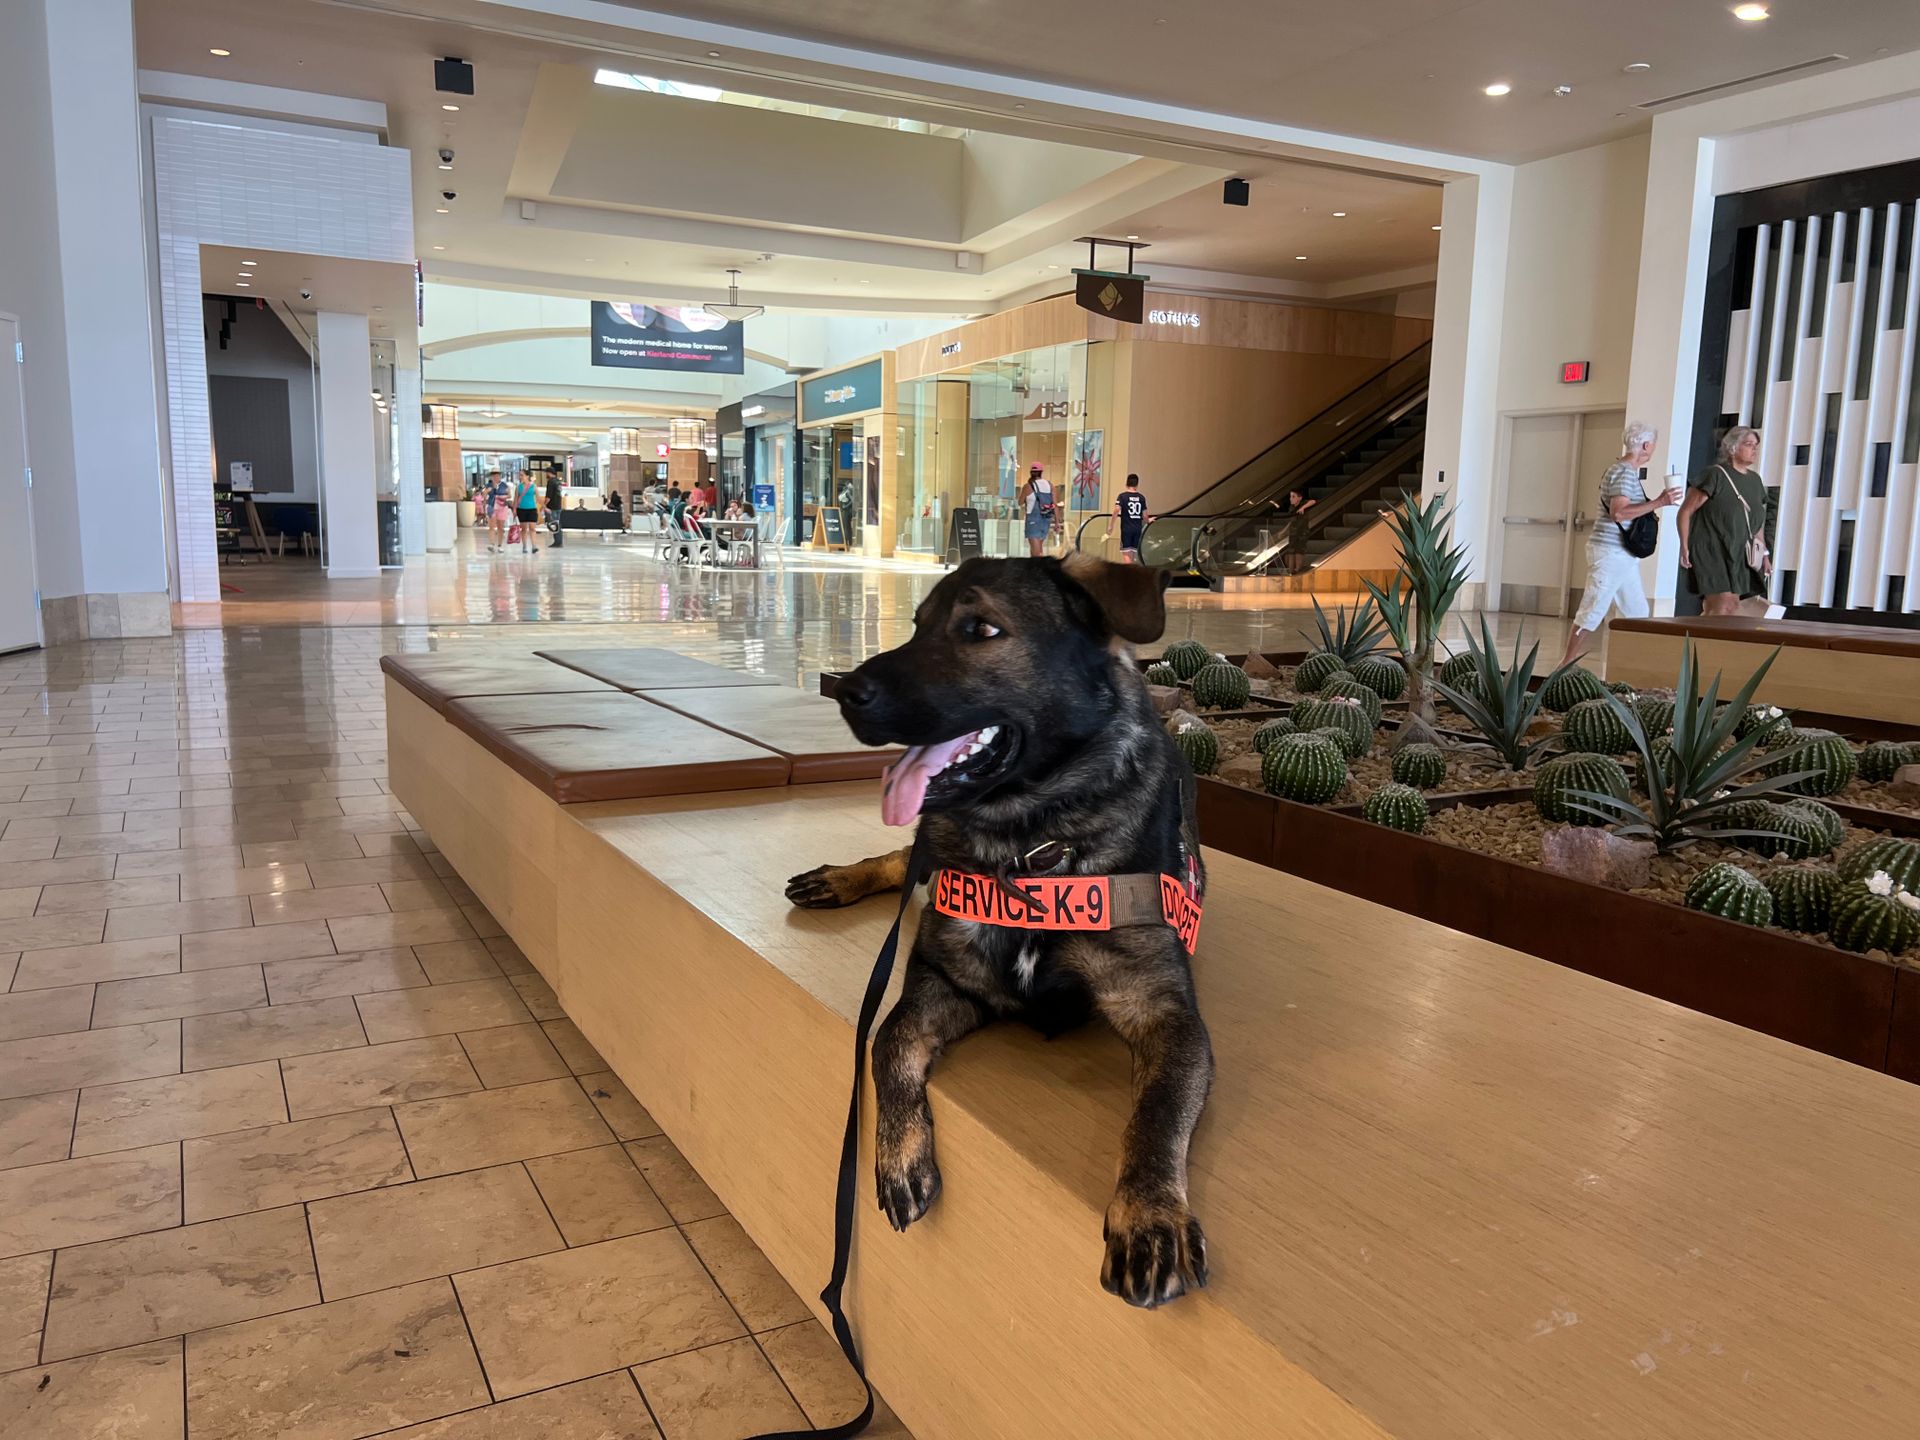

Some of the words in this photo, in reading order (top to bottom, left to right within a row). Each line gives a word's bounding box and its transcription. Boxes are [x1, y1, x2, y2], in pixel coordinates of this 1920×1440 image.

[602, 335, 616, 344] The
[617, 338, 644, 346] modern
[672, 341, 692, 349] home
[602, 347, 618, 355] Now
[1127, 501, 1142, 515] 30
[939, 869, 1045, 923] SERVICE
[1054, 884, 1103, 924] K-9
